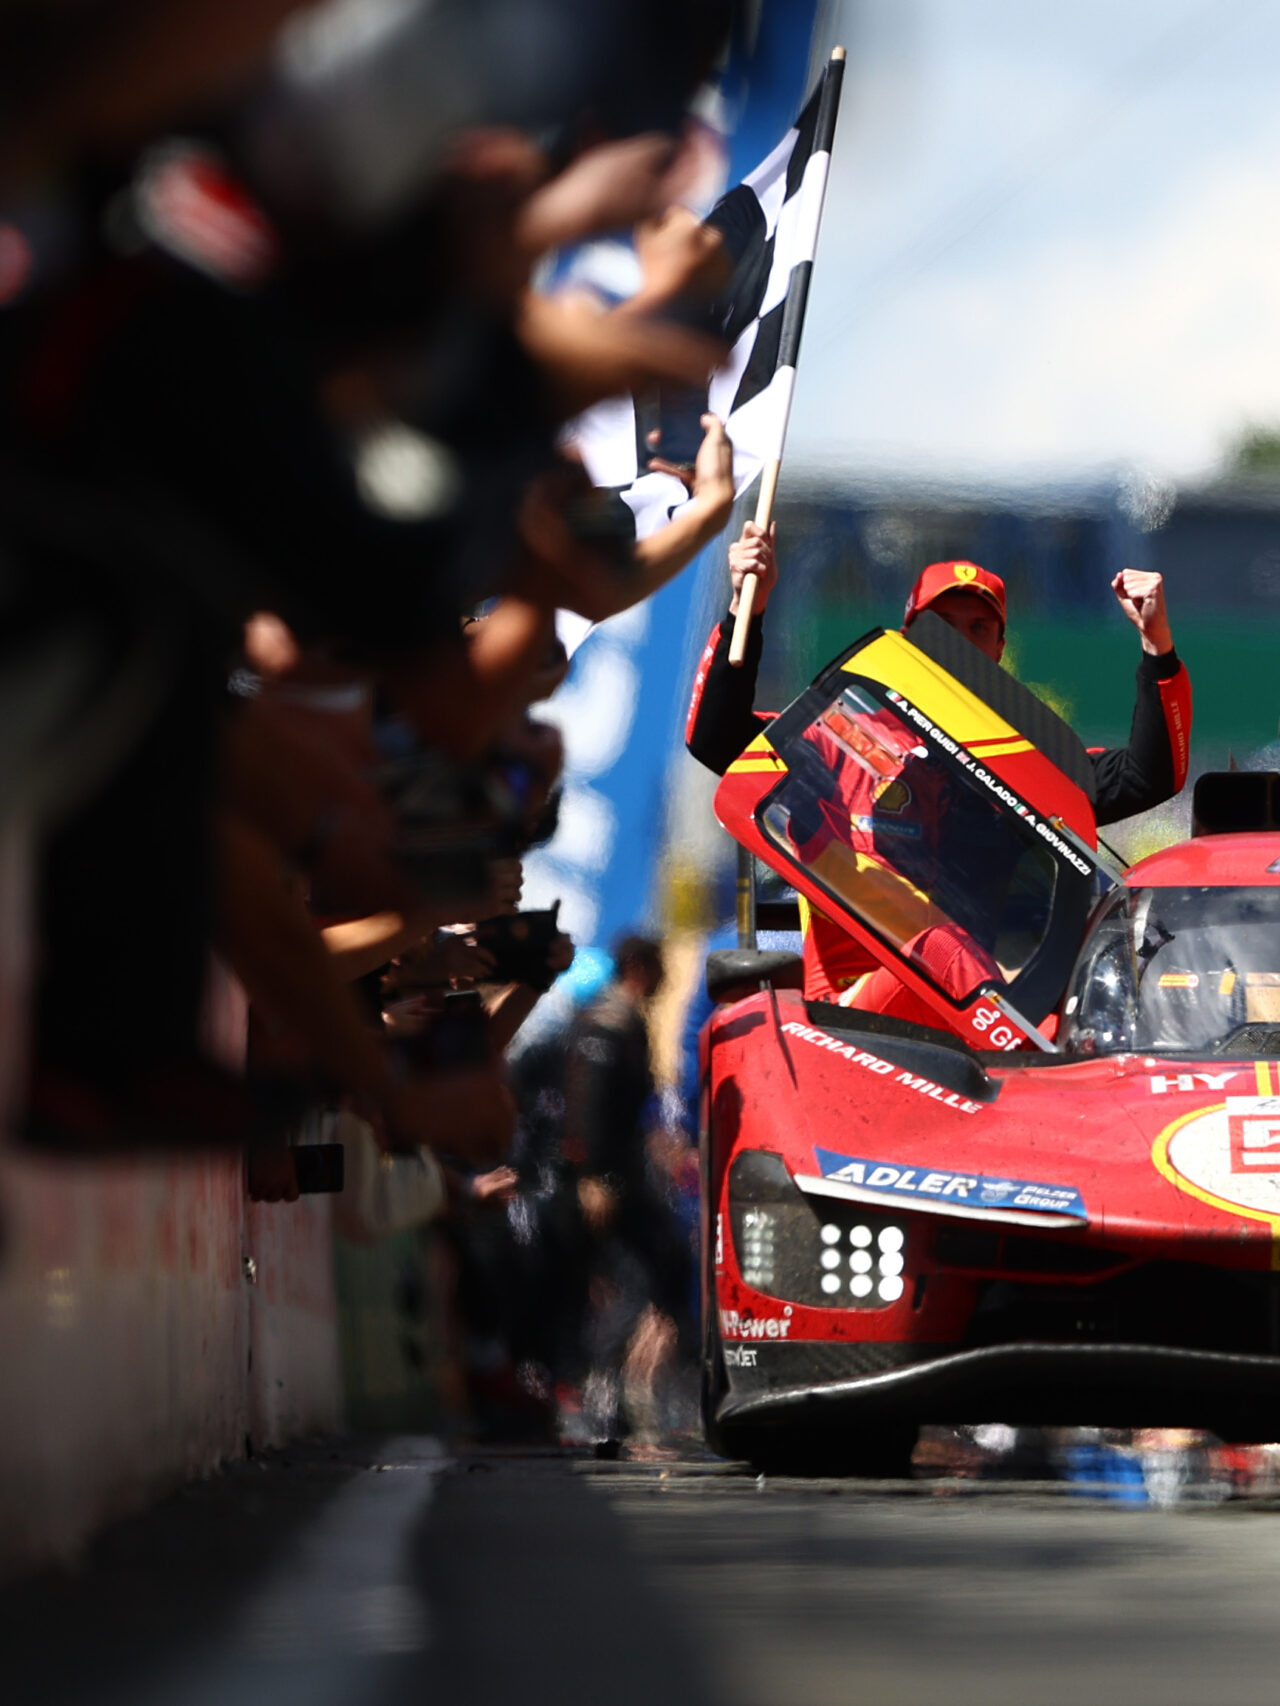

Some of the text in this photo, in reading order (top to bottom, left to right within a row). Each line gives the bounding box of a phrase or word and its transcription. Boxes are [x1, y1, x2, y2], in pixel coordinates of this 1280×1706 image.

[896, 699, 960, 756] A. PIER GUIDI
[965, 762, 1018, 808] J. CALADO
[1024, 813, 1092, 876] A. GIOVINAZZI
[781, 1021, 984, 1114] RICHARD MILLE
[1150, 1073, 1238, 1094] HY
[825, 1162, 978, 1198] ADLER
[1021, 1185, 1078, 1200] PELZER
[1012, 1194, 1071, 1209] GROUP
